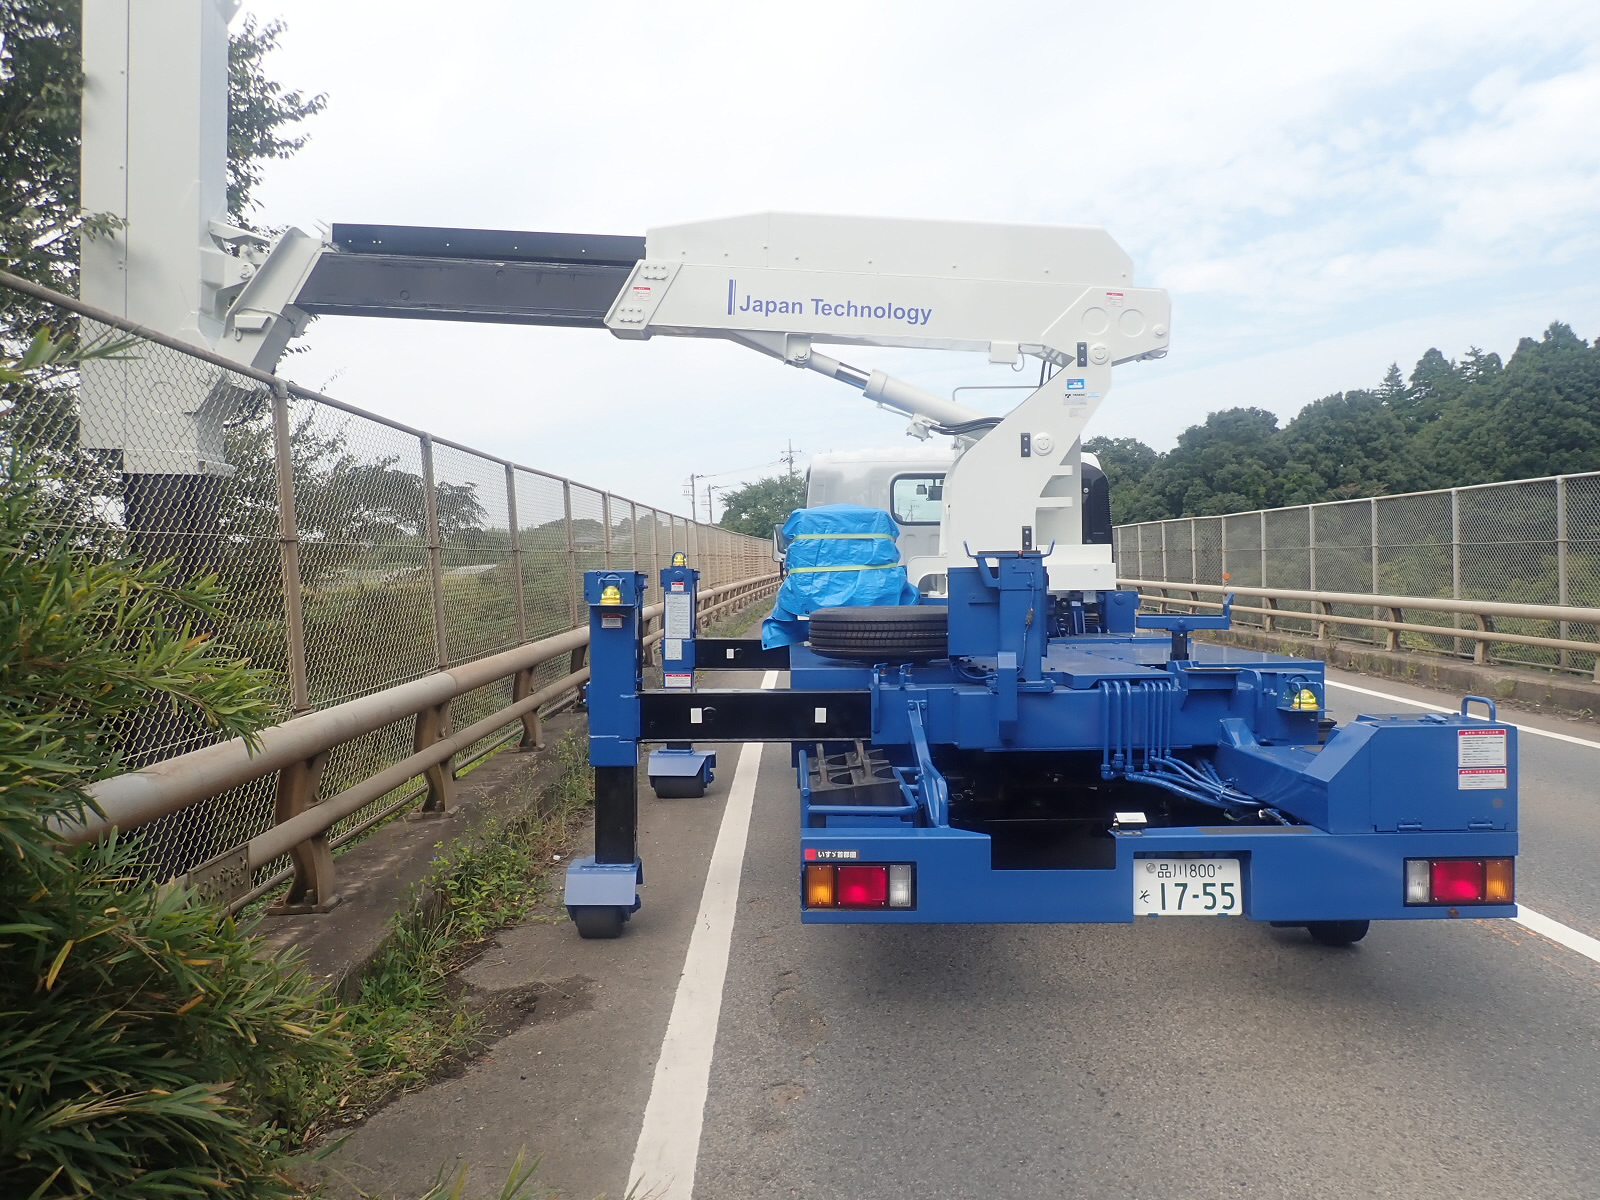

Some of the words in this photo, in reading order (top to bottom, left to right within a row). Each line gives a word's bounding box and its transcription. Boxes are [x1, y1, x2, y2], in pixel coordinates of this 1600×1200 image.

[739, 295, 803, 317] Japan
[811, 298, 933, 326] Technology
[1157, 863, 1216, 879] 品川800
[1139, 889, 1151, 904] そ
[1160, 882, 1236, 911] 17-55
